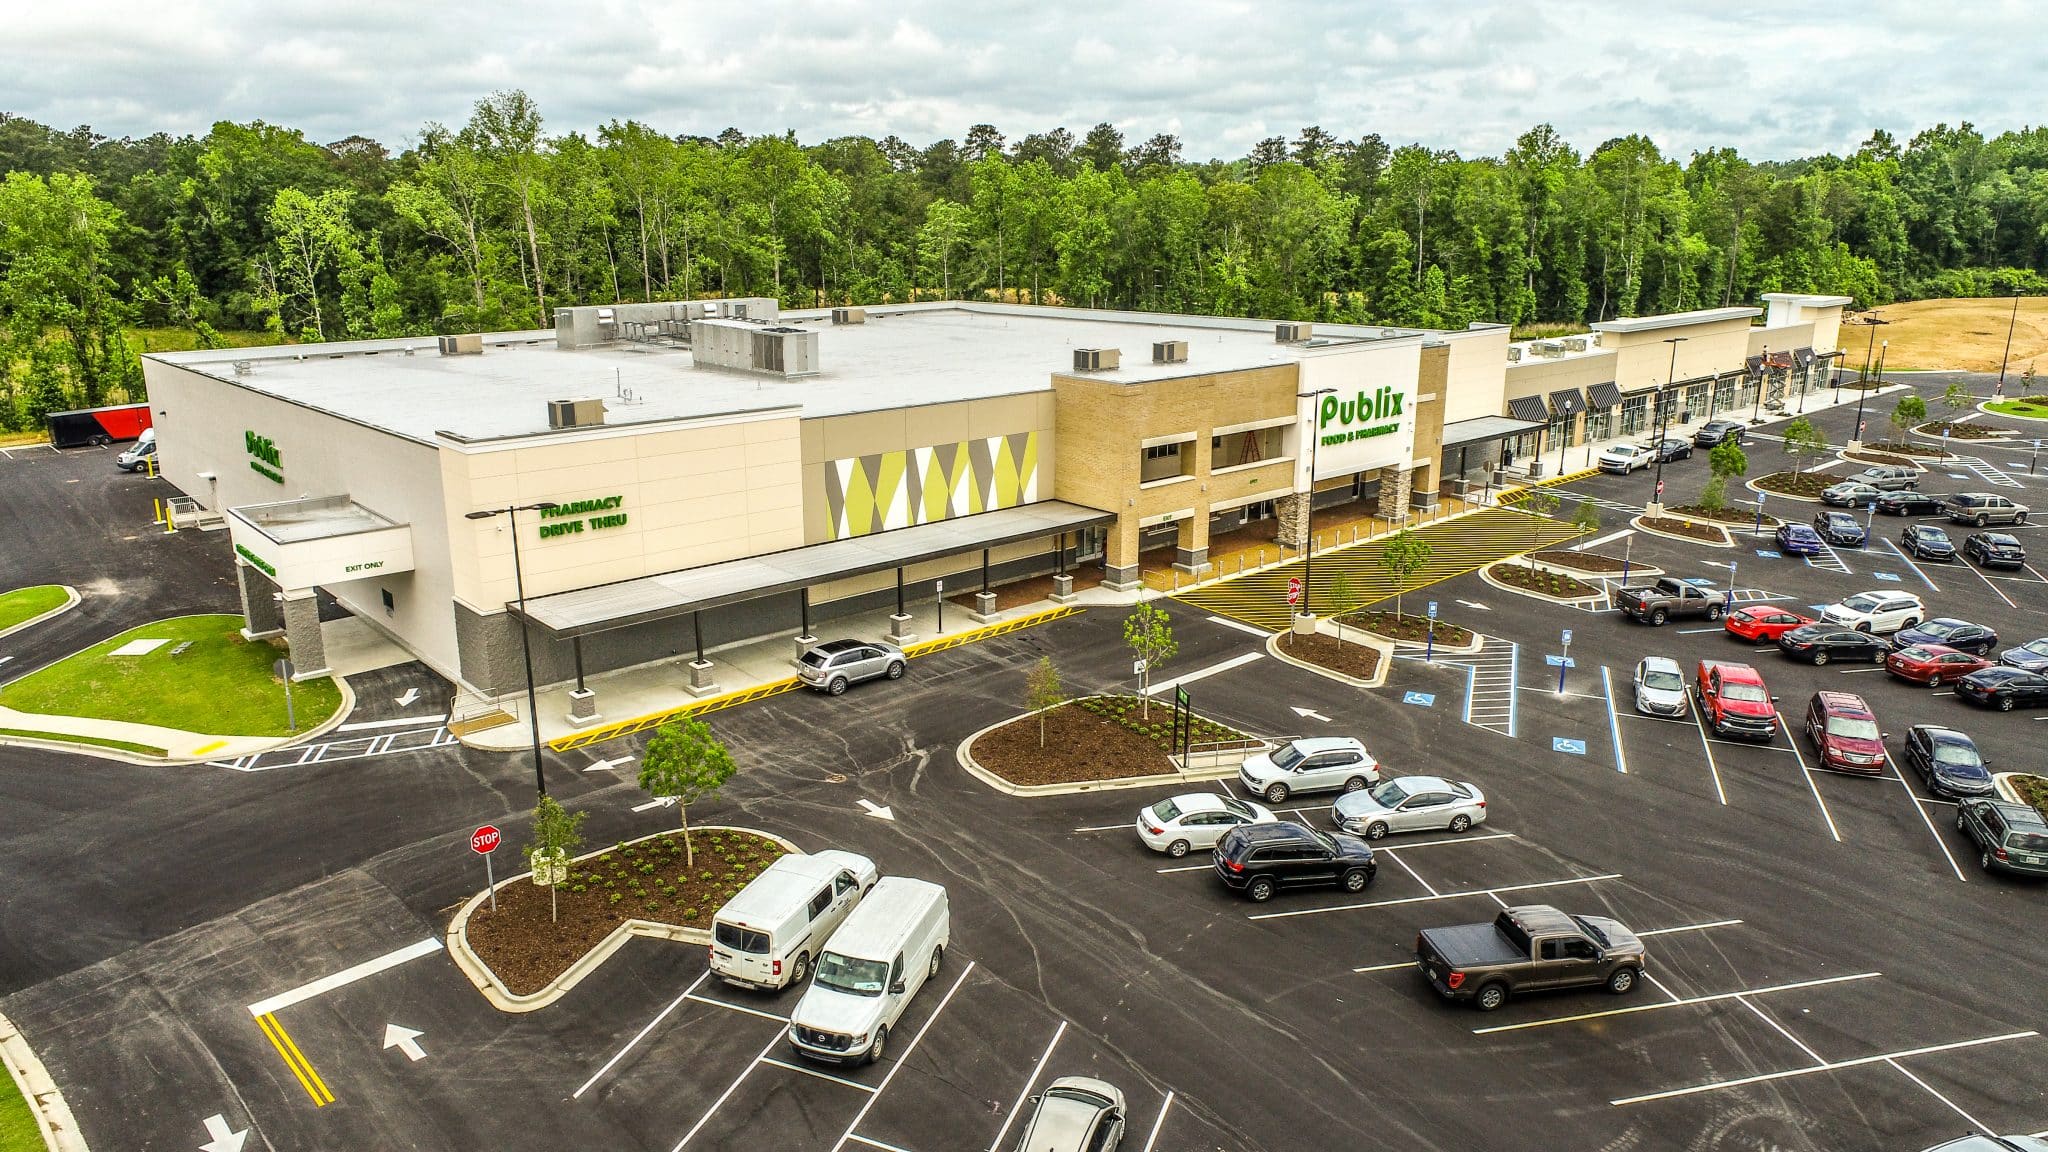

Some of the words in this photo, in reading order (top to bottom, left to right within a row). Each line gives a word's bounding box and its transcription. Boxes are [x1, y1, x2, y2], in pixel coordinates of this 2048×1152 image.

[1321, 386, 1404, 429] Publix
[1321, 434, 1346, 446] FOOD
[1347, 431, 1354, 441] &
[1356, 423, 1400, 440] PHARMACY
[540, 495, 622, 519] PHARMACY
[540, 521, 584, 538] DRIVE
[589, 514, 627, 529] THRU
[345, 564, 363, 573] EXIT
[363, 560, 384, 570] ONLY
[473, 831, 499, 848] STOP
